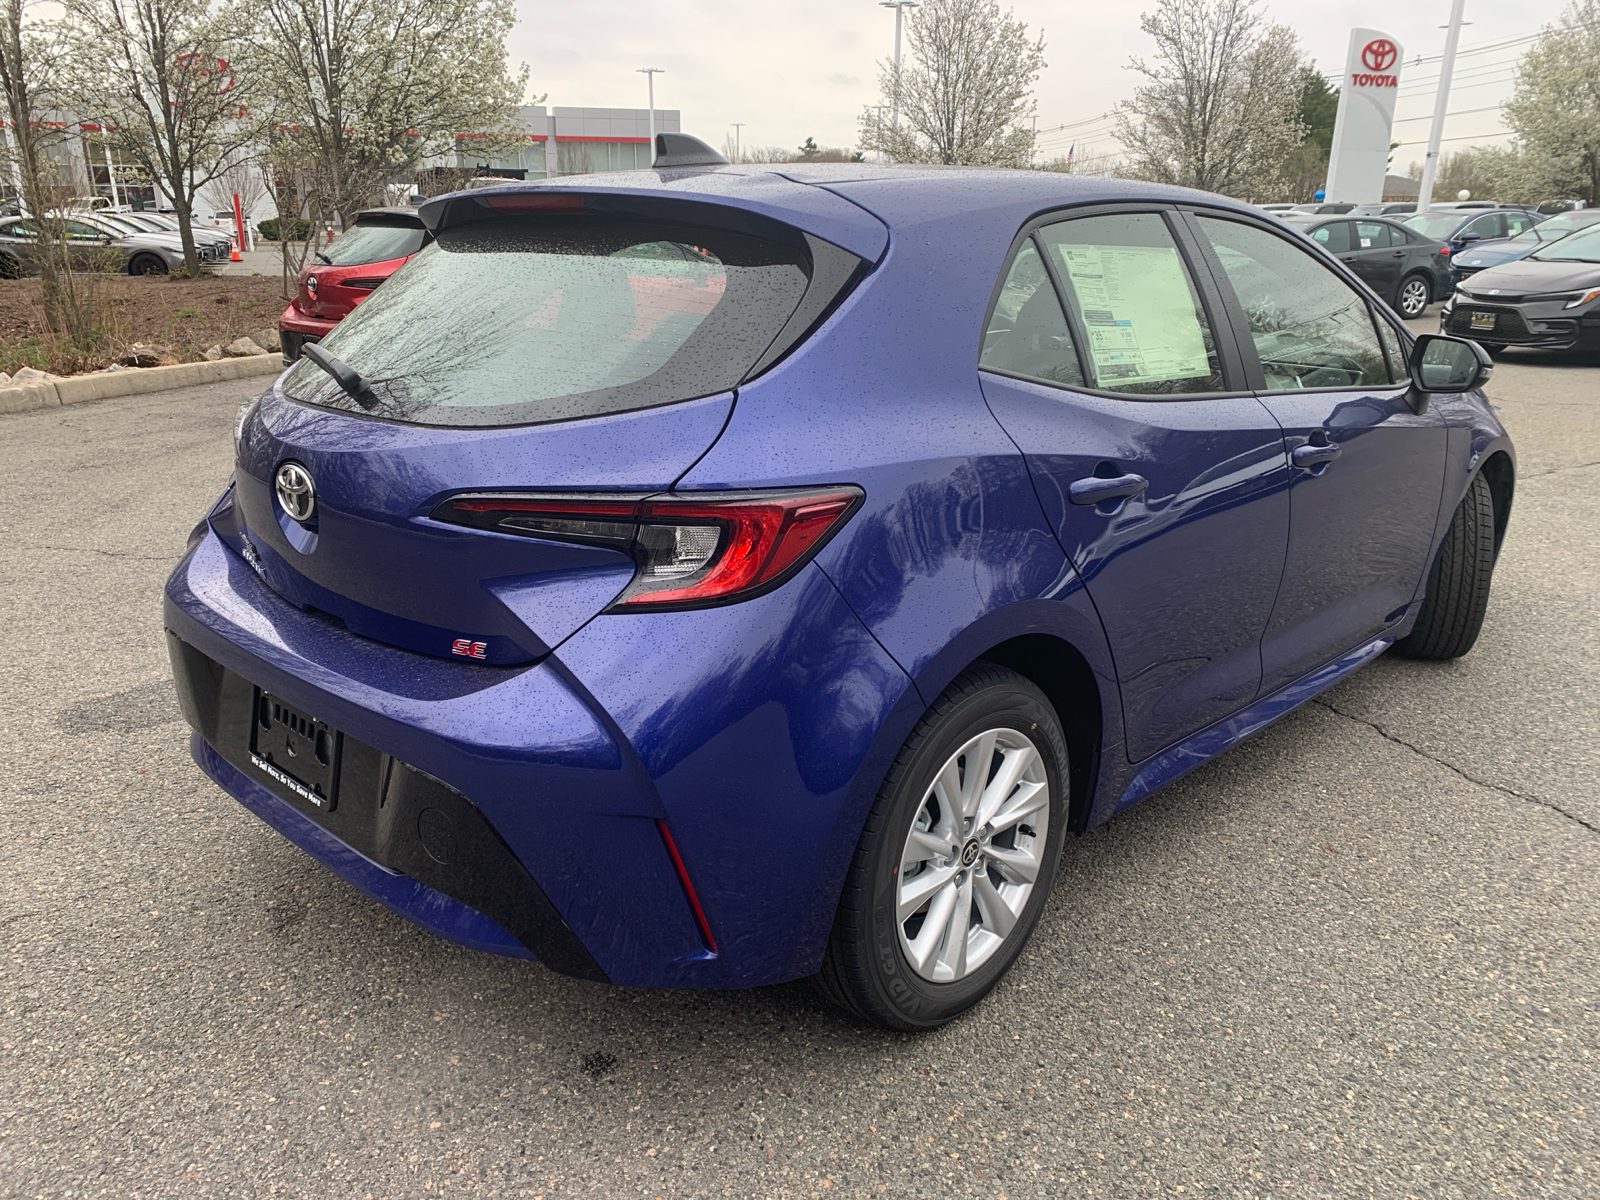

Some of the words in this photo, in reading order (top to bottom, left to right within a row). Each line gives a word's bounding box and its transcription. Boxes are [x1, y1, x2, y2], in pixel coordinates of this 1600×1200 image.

[1352, 73, 1398, 88] TOYOTA
[451, 638, 488, 660] SE
[251, 755, 259, 766] We
[259, 760, 267, 771] Sell
[267, 766, 280, 781] More,
[280, 775, 287, 784] So
[287, 778, 296, 791] You
[296, 785, 308, 799] Save
[308, 793, 321, 807] More
[1044, 717, 1069, 814] YOKOHAMA
[879, 944, 896, 976] GT
[889, 978, 938, 1018] AVID
